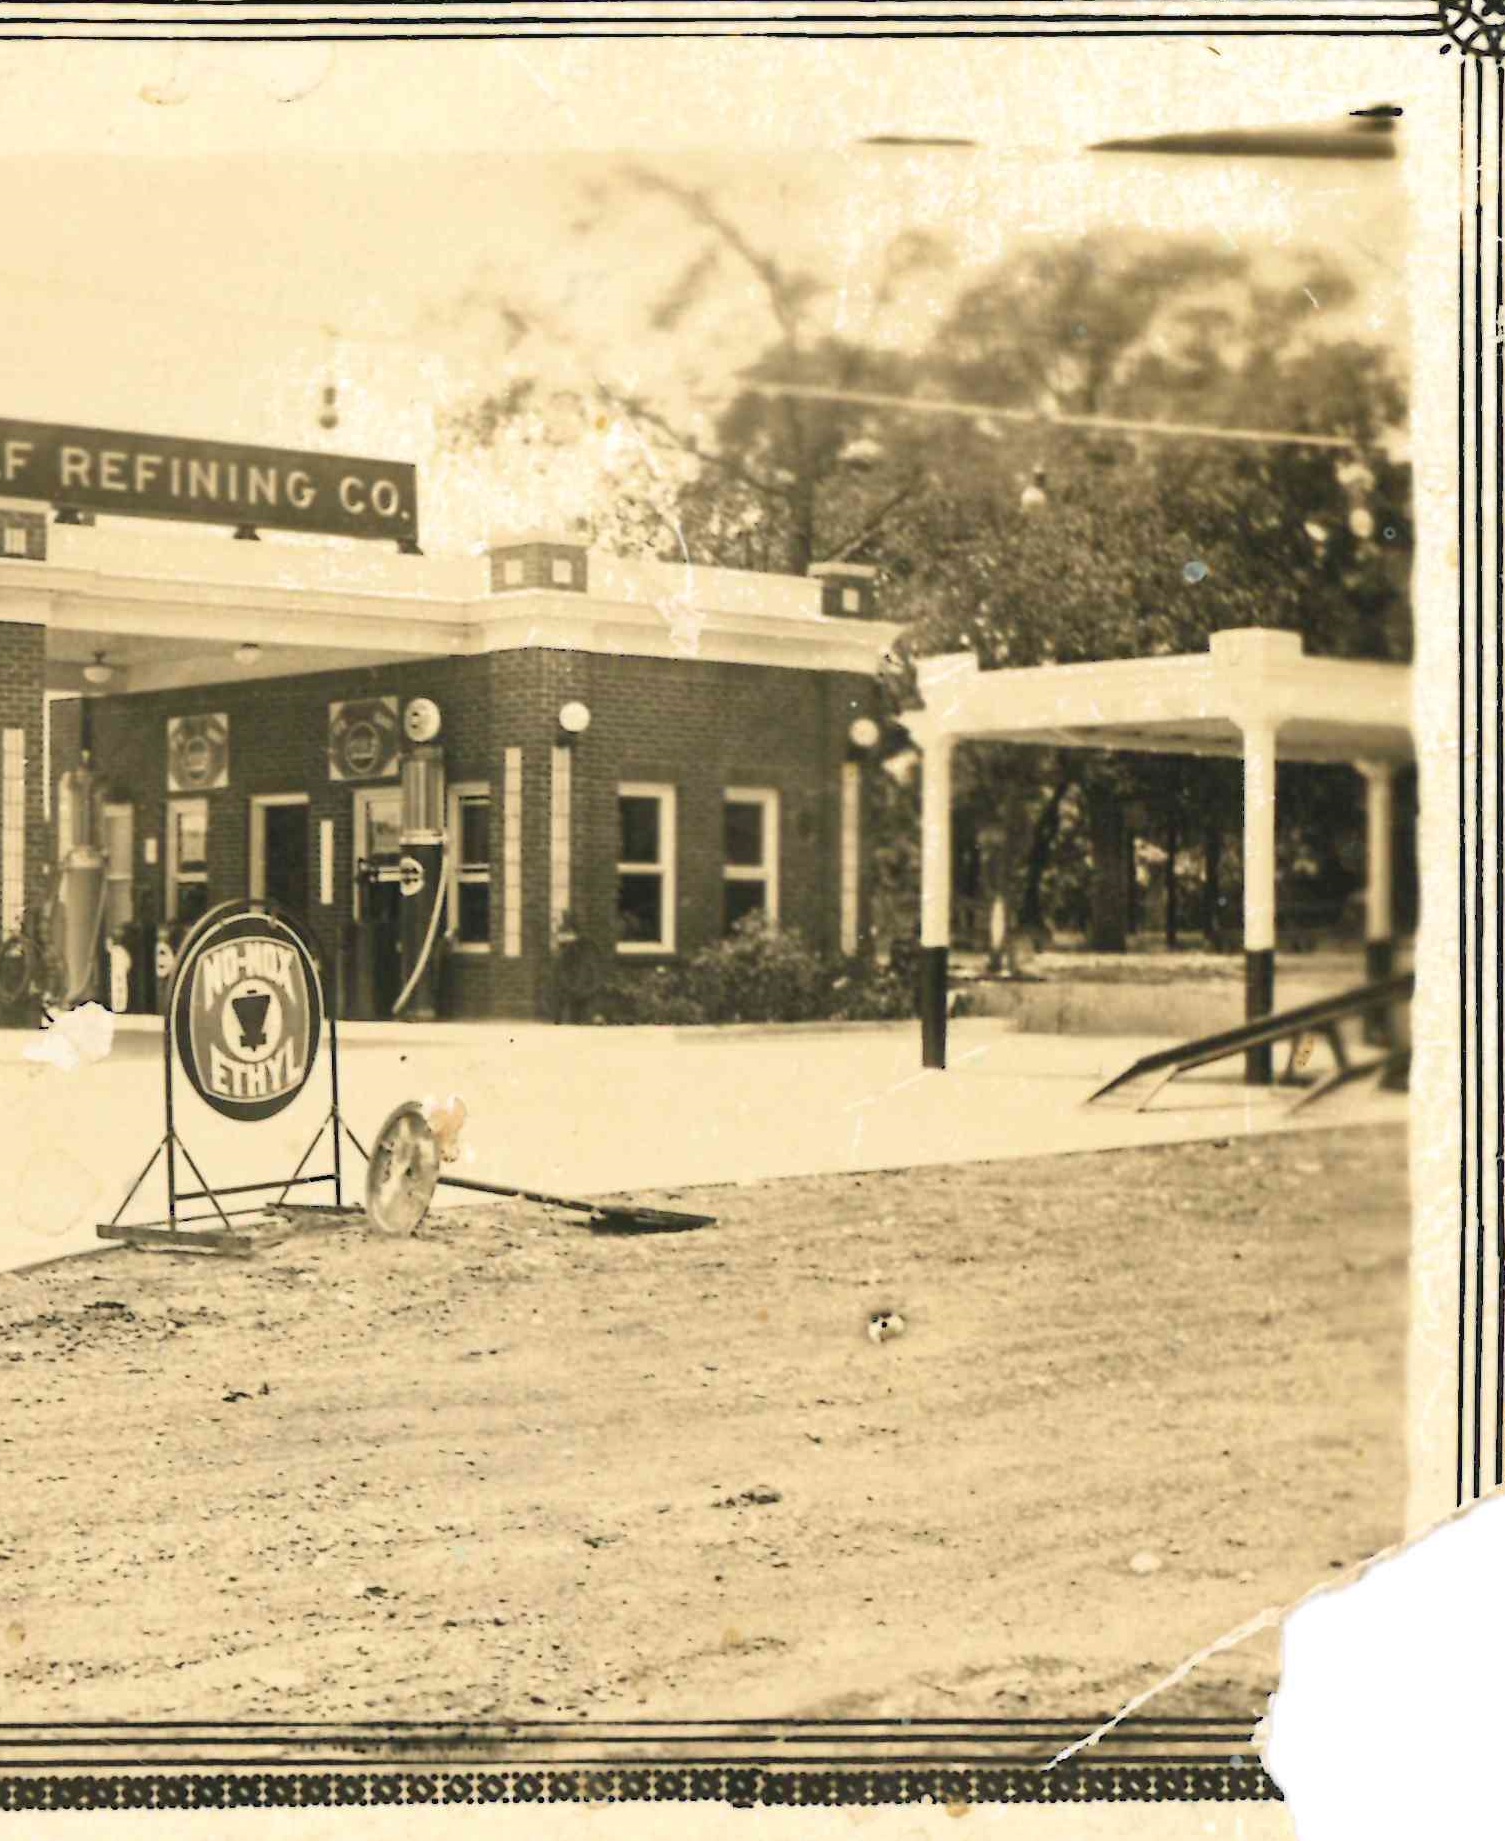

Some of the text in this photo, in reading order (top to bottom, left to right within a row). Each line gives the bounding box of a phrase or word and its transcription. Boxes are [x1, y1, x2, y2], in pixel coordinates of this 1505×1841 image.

[60, 446, 318, 509] REFINING
[338, 476, 411, 521] CO.
[203, 941, 297, 1011] NO-NOX
[210, 1036, 304, 1097] ETHYL
